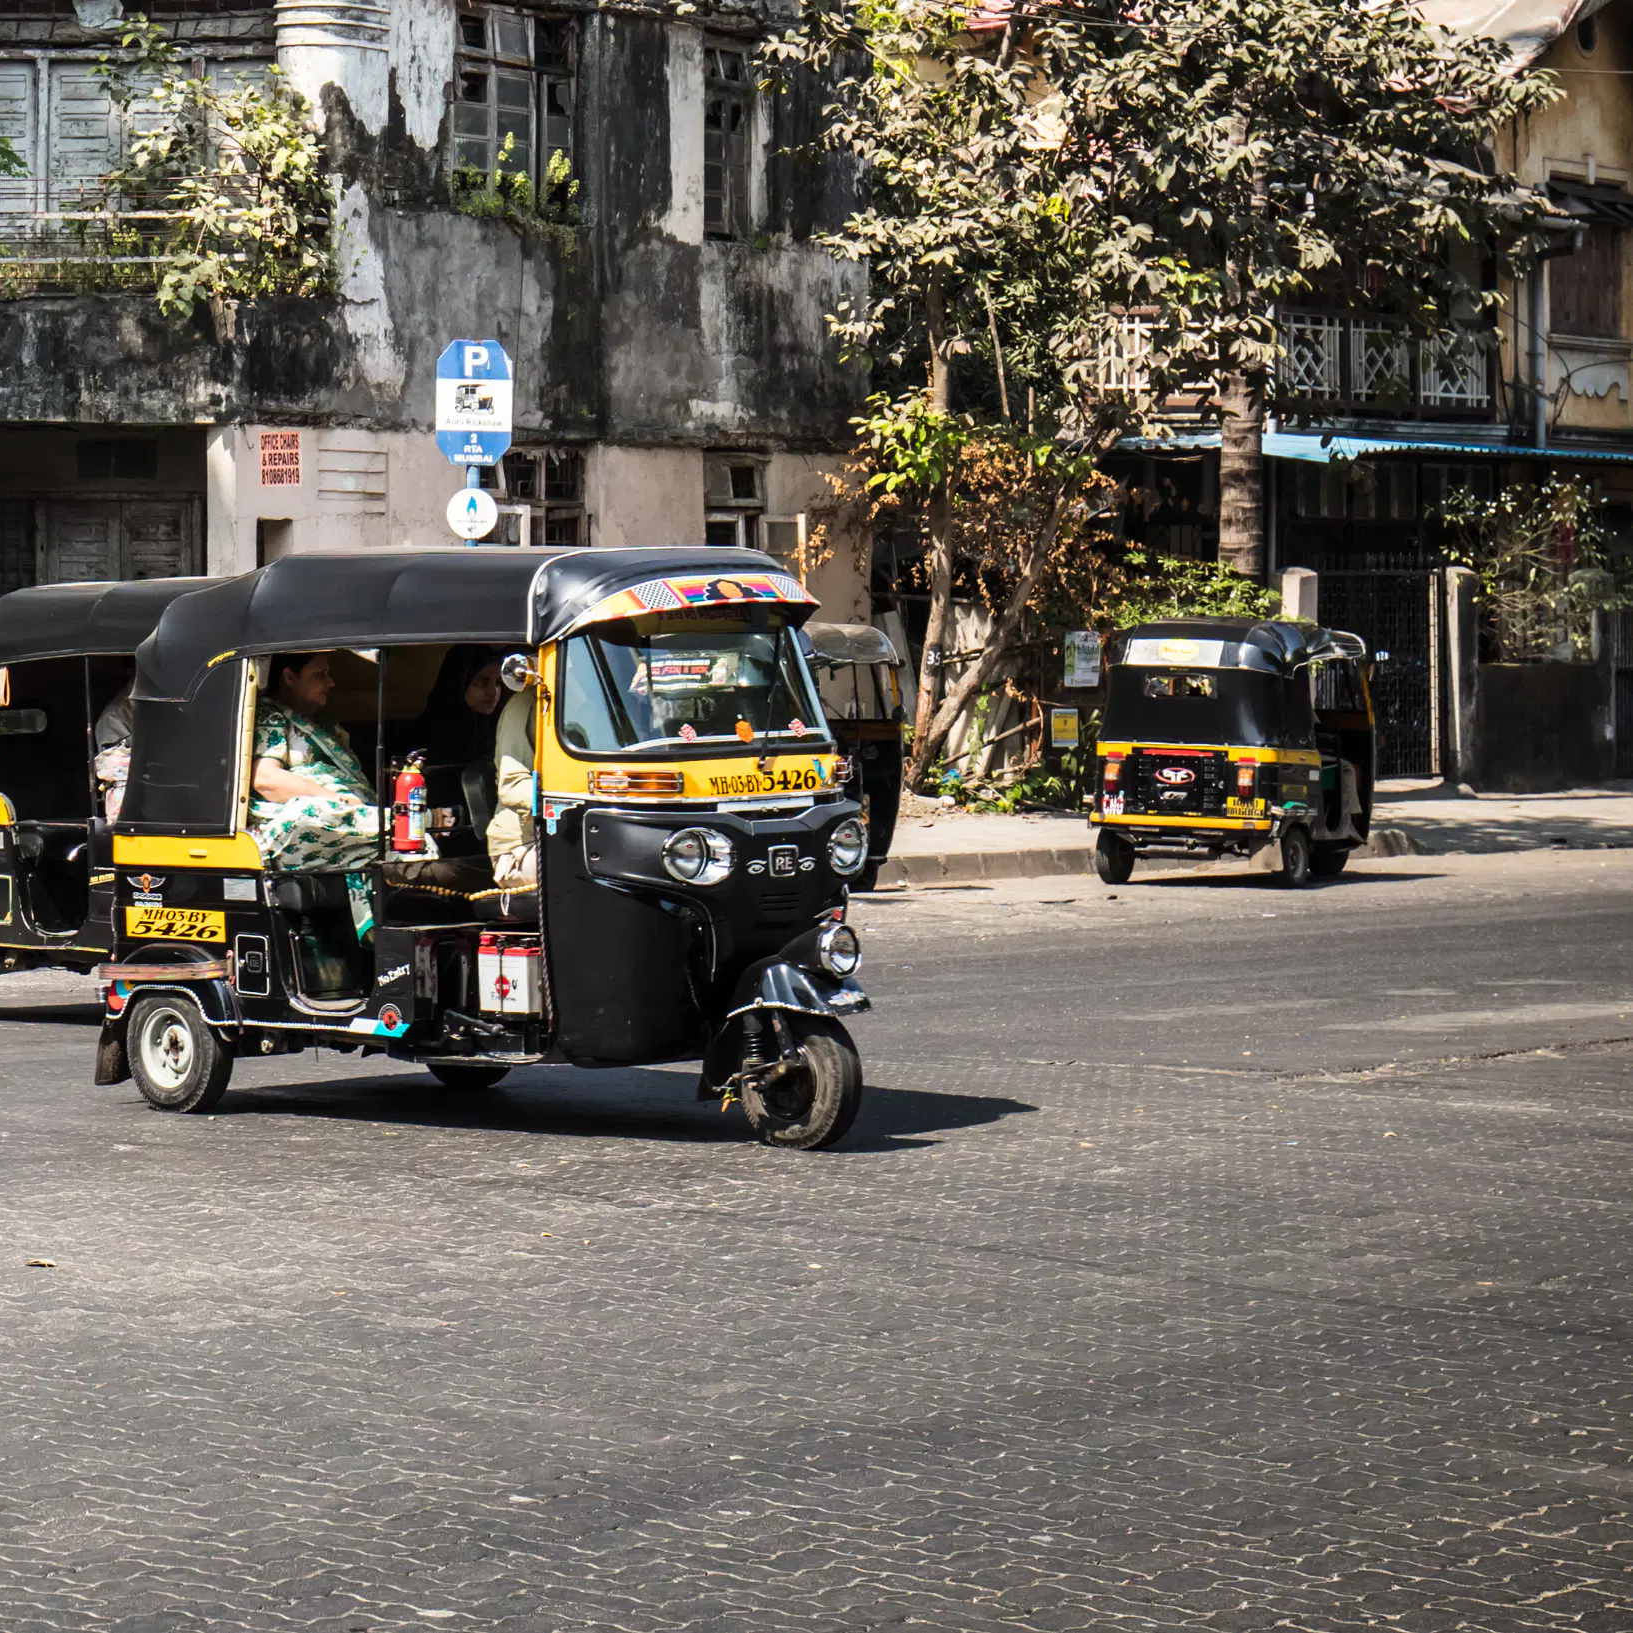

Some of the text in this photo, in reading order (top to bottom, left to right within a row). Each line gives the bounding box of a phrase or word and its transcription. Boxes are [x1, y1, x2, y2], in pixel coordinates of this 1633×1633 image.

[464, 345, 489, 377] P
[445, 418, 503, 427] Auto Rickshaw
[260, 433, 299, 451] OFFICE CHAIRS
[470, 433, 478, 444] 2
[463, 444, 483, 454] RTA
[268, 452, 300, 466] REPAIRS
[453, 454, 493, 463] MUMBAI
[926, 650, 942, 666] 35
[775, 856, 794, 871] RE
[131, 920, 222, 939] 5426
[376, 963, 411, 987] No Entry
